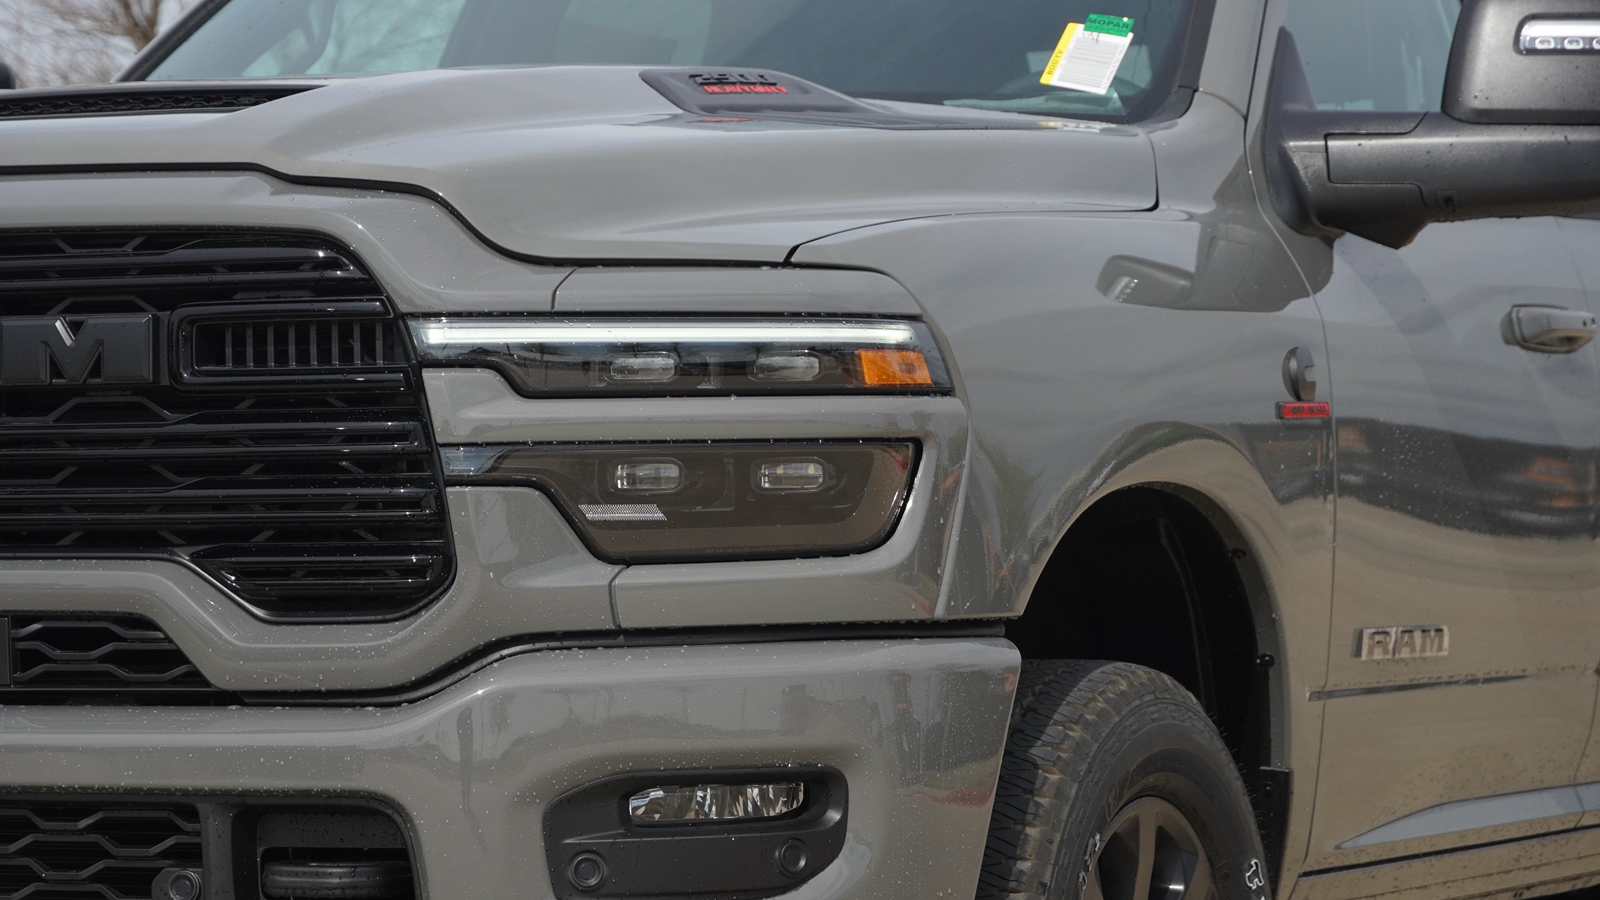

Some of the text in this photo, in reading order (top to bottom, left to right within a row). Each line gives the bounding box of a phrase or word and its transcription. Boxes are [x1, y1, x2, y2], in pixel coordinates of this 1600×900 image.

[1086, 17, 1130, 29] MOPAR
[703, 85, 788, 95] HEAVY DUTY
[1356, 625, 1450, 660] RAM
